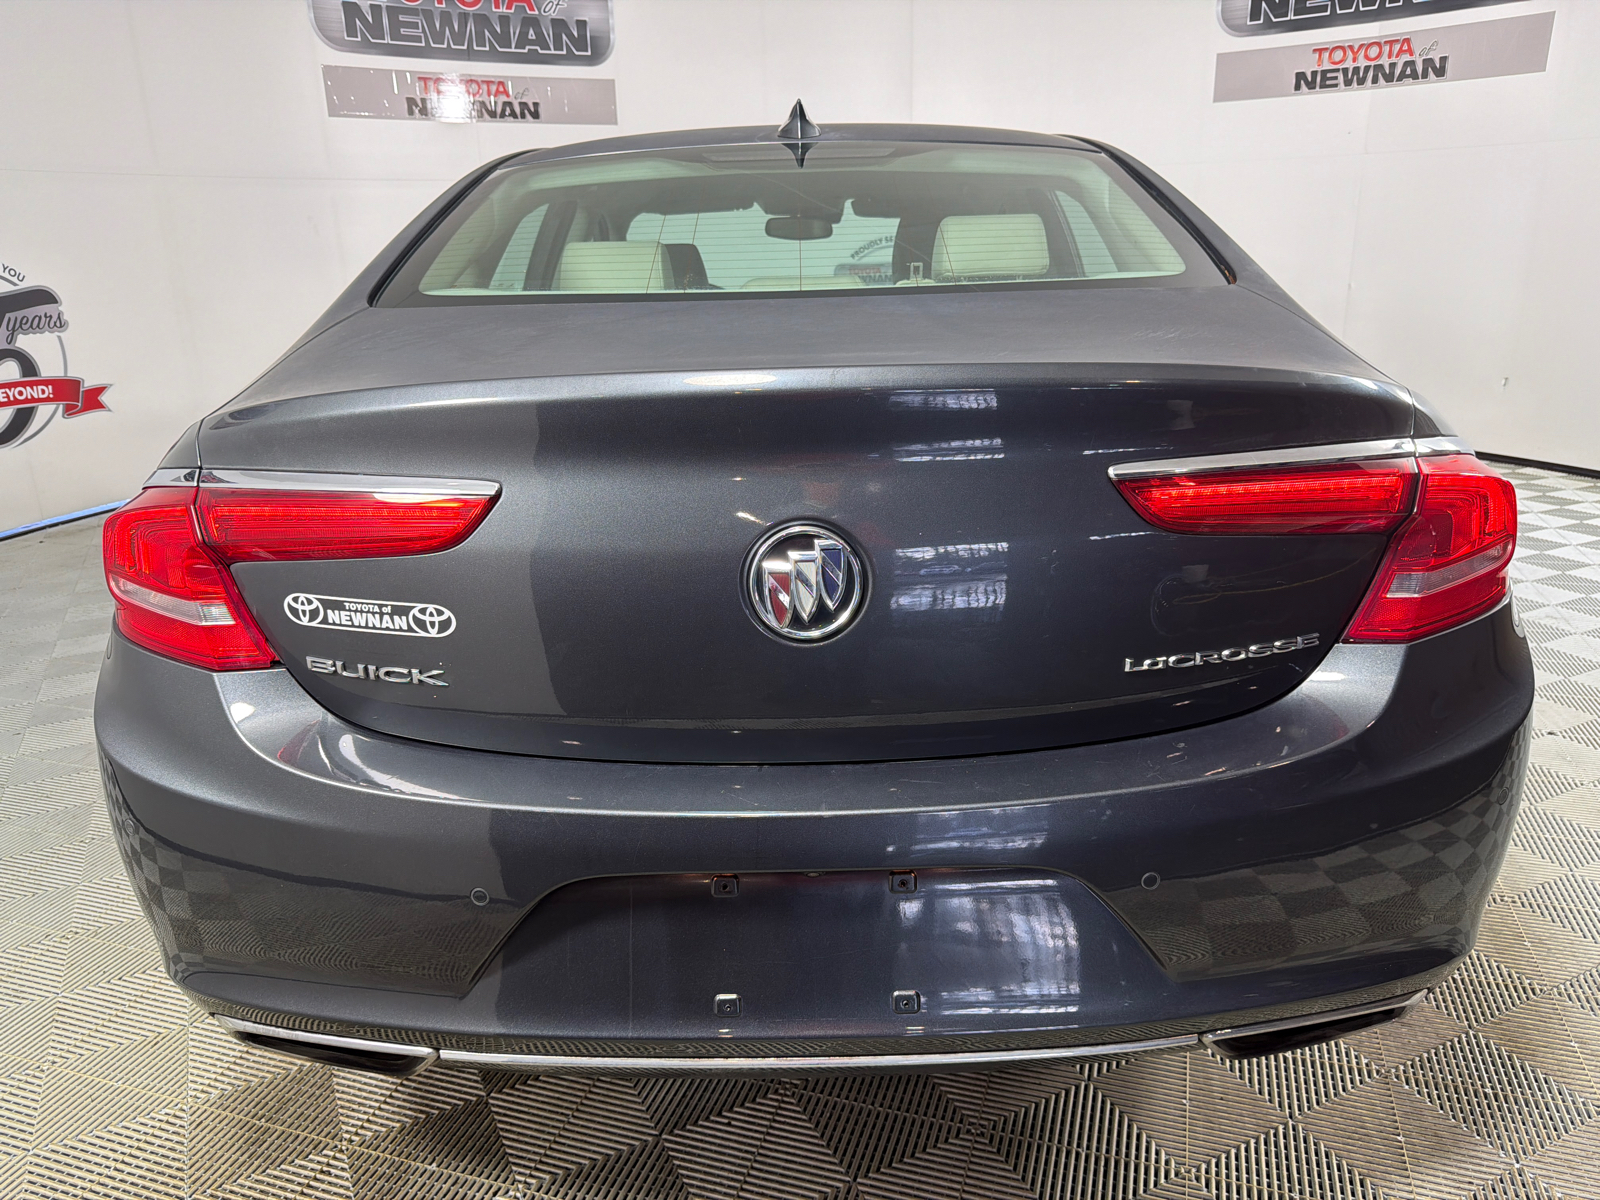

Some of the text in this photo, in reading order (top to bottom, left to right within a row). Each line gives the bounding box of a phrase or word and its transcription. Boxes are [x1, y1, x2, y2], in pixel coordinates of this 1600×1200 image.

[341, 0, 591, 55] NEWNAN
[1312, 37, 1438, 67] TOYOTA of
[1294, 55, 1449, 92] NEWNAN
[417, 76, 511, 99] TOOTA
[405, 96, 540, 120] NNAN
[1, 262, 26, 283] YOU
[5, 311, 67, 346] years
[327, 609, 408, 630] NEWNAN
[343, 602, 392, 614] TOYOTA of
[306, 655, 449, 686] BUICK
